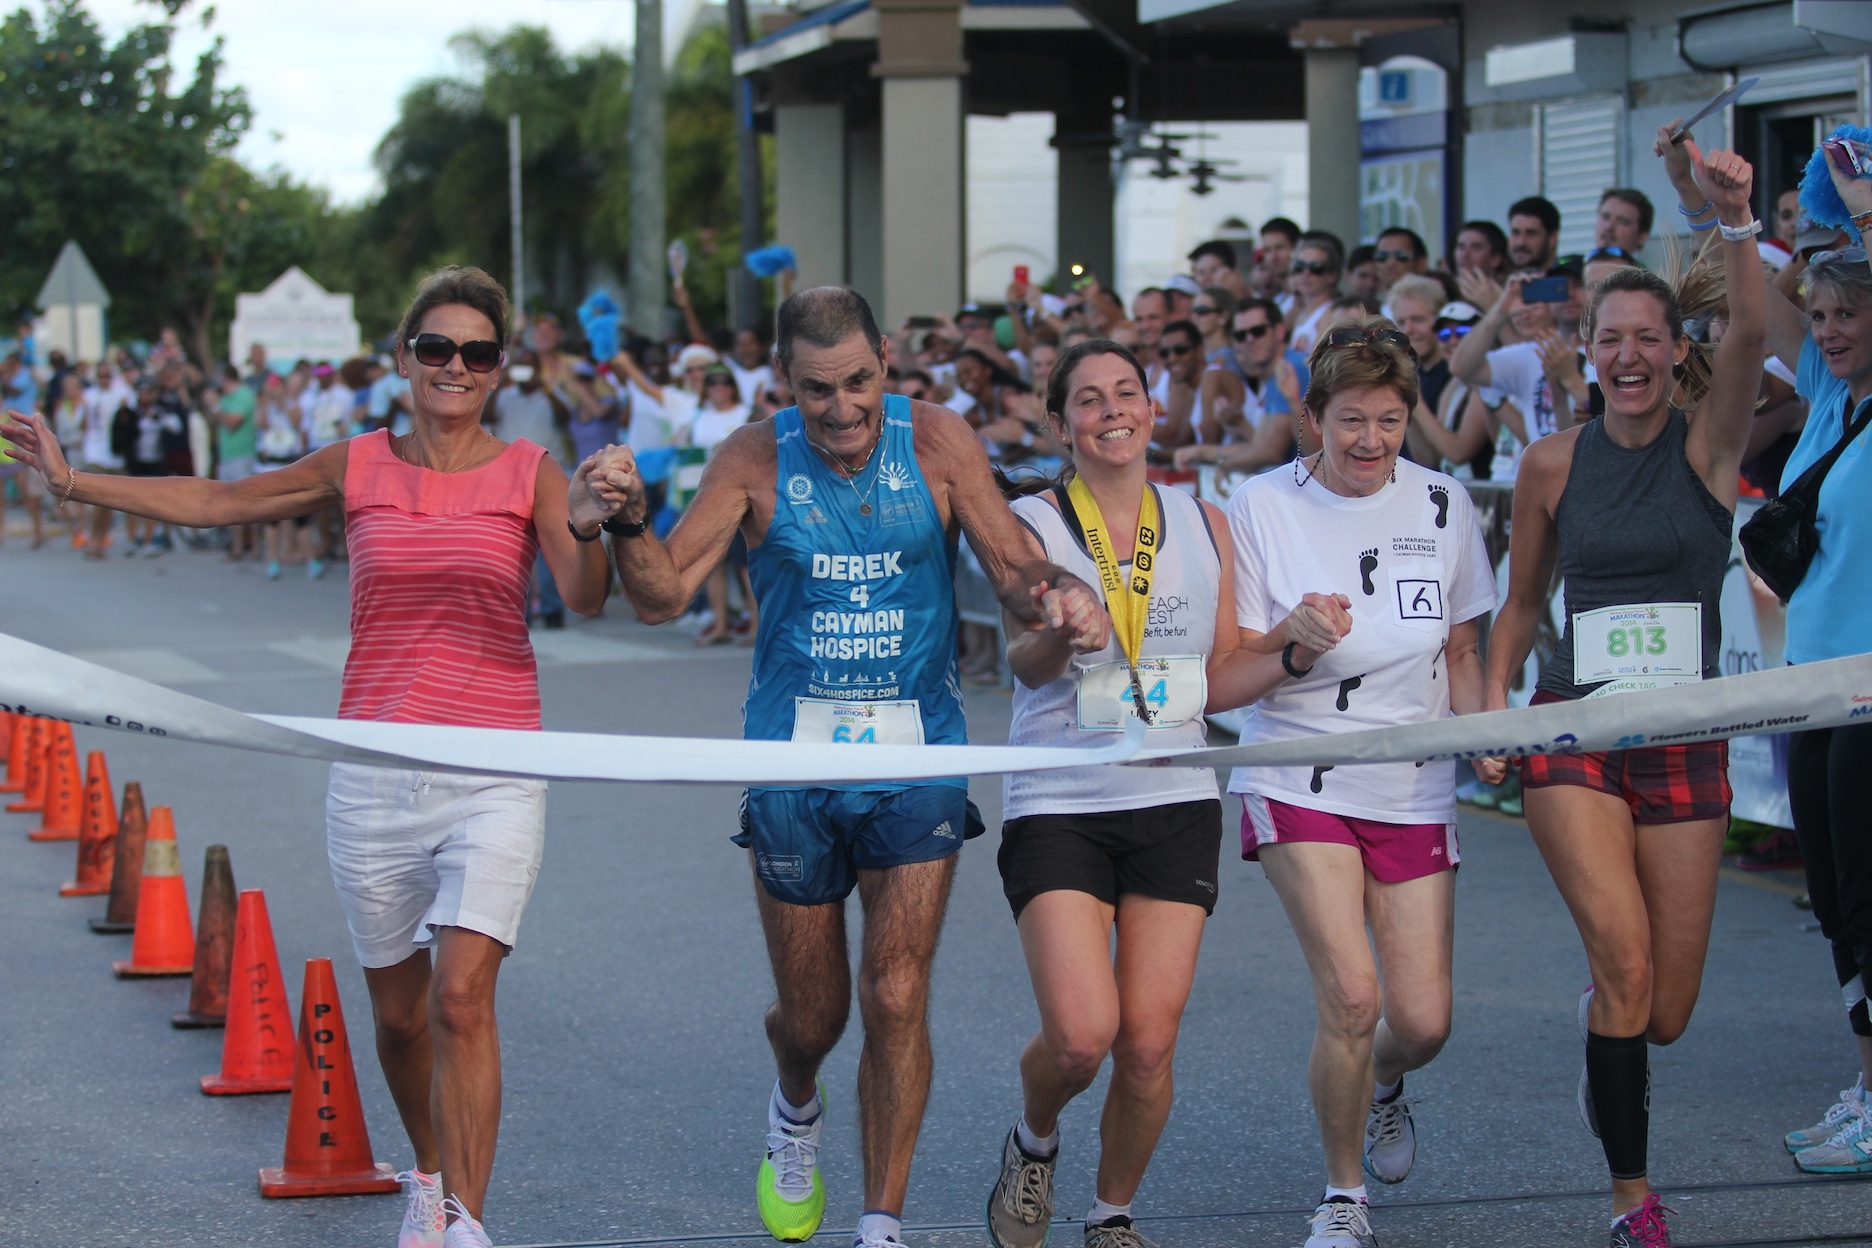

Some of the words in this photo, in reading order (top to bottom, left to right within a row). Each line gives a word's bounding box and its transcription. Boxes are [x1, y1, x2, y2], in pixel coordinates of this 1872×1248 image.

[1087, 527, 1117, 592] Intertrust
[1392, 543, 1437, 553] CHALLENGE
[811, 551, 904, 581] DEREK
[850, 584, 869, 608] 4
[811, 609, 904, 634] CAYMAN
[1610, 613, 1645, 622] MARATHON
[1144, 628, 1153, 638] Be
[1164, 627, 1174, 637] be
[1607, 626, 1667, 657] 813
[810, 635, 903, 660] HOSPICE
[808, 683, 900, 699] SIX4HOSPICE.COM
[1608, 682, 1637, 692] CHECK
[1639, 682, 1657, 690] TAG
[833, 709, 864, 717] MARATHON
[832, 723, 879, 744] 64
[1650, 729, 1708, 742] Flowers
[1710, 719, 1764, 735] Bottled
[1767, 714, 1810, 727] Water
[314, 1003, 337, 1147] POLICE
